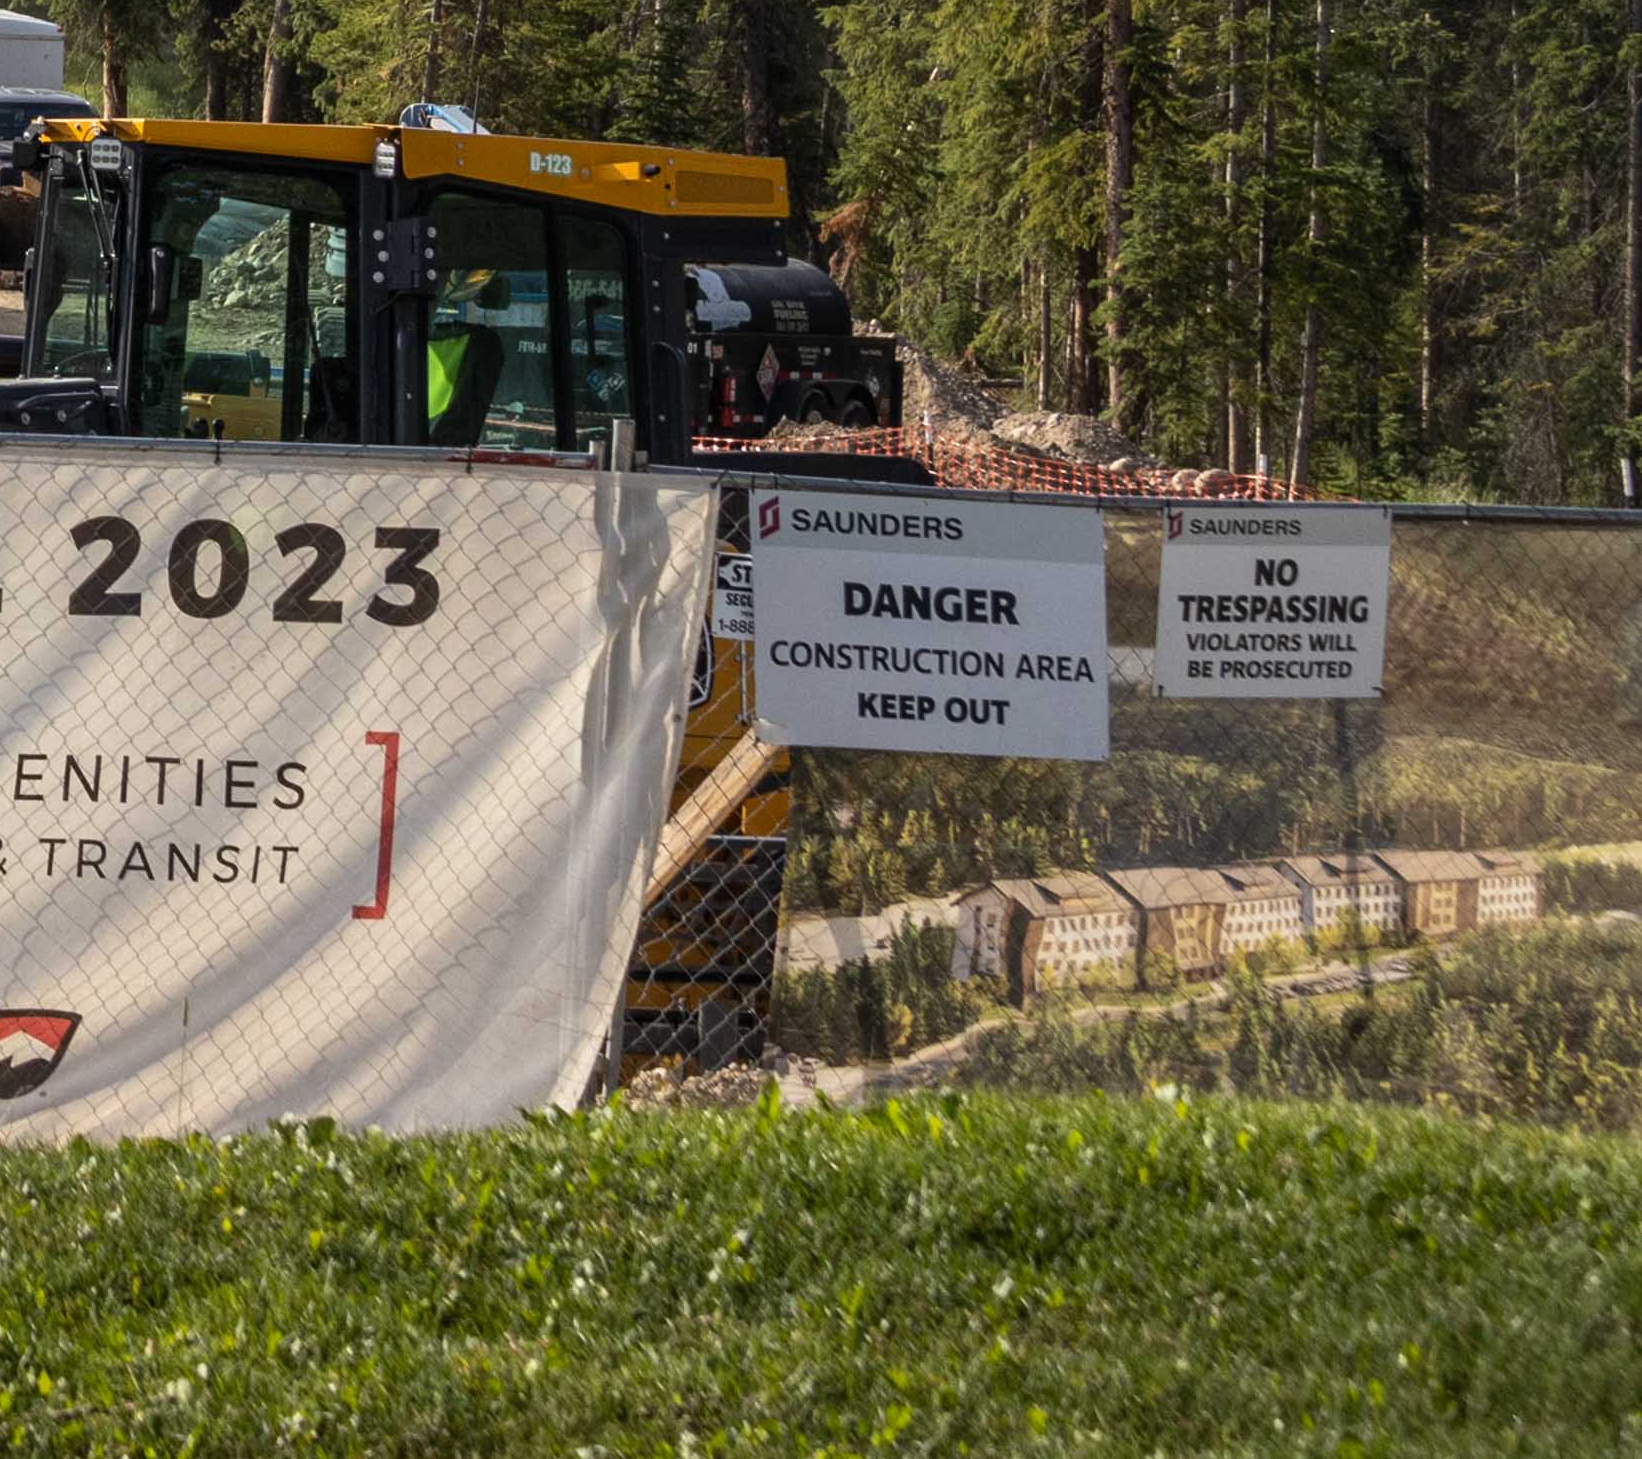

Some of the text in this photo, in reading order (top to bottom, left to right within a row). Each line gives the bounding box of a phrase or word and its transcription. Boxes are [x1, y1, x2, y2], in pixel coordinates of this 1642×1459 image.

[530, 151, 573, 175] D-123
[791, 508, 964, 541] SAUNDERS
[1189, 516, 1302, 537] SAUNDERS
[68, 515, 441, 627] 2023
[1255, 558, 1300, 587] NO
[842, 581, 1020, 626] DANGER
[1178, 594, 1369, 624] TRESPASSING
[1187, 632, 1358, 653] VIOLATORS WILL
[769, 639, 1094, 682] CONSTRUCTION AREA
[1188, 659, 1354, 680] BE PROSECUTED
[857, 691, 1011, 725] KEEP OUT
[42, 836, 300, 885] TRANSIT
